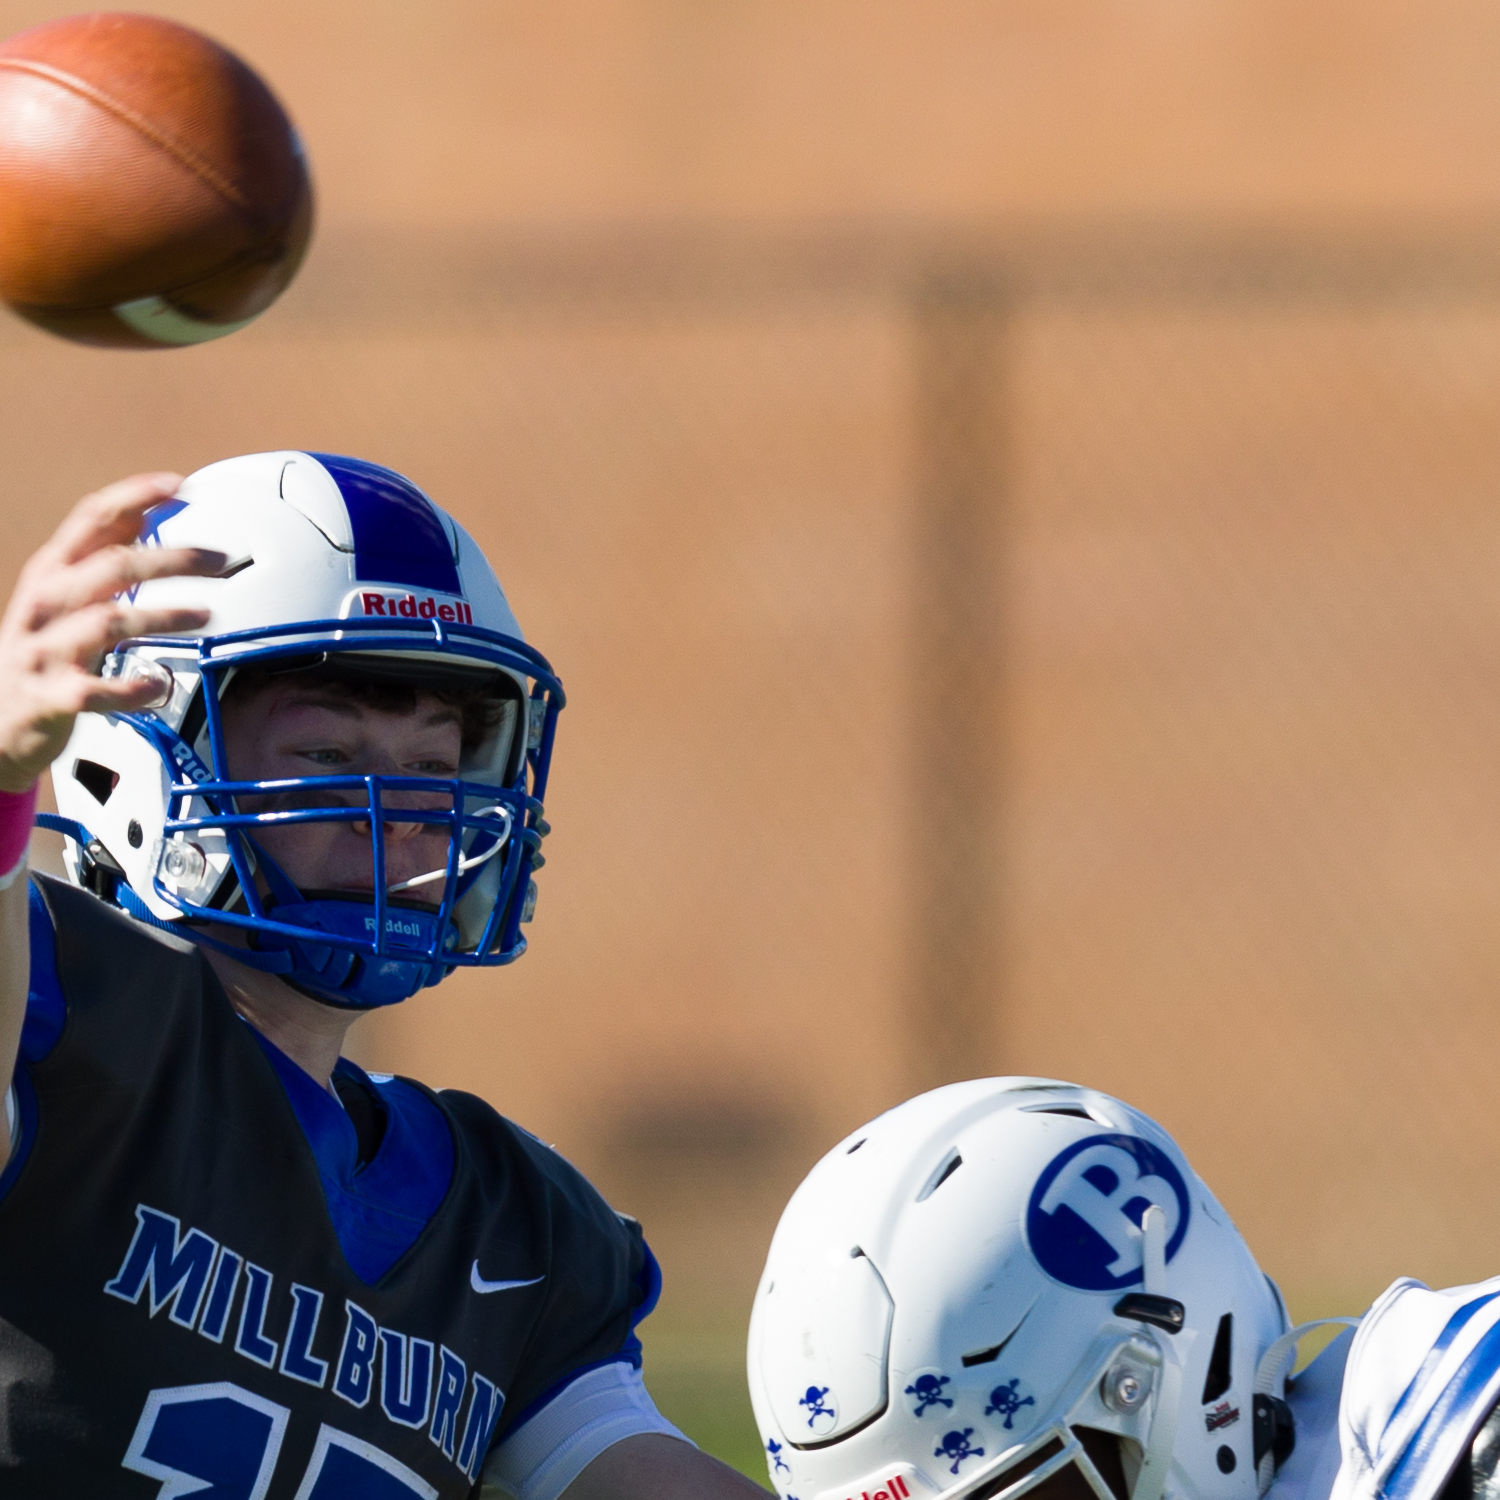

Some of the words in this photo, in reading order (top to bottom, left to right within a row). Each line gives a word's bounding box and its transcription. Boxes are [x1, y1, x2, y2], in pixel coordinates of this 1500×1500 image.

[361, 592, 473, 626] Riddell
[364, 917, 421, 937] Rddell
[103, 1203, 506, 1487] MILLBURN
